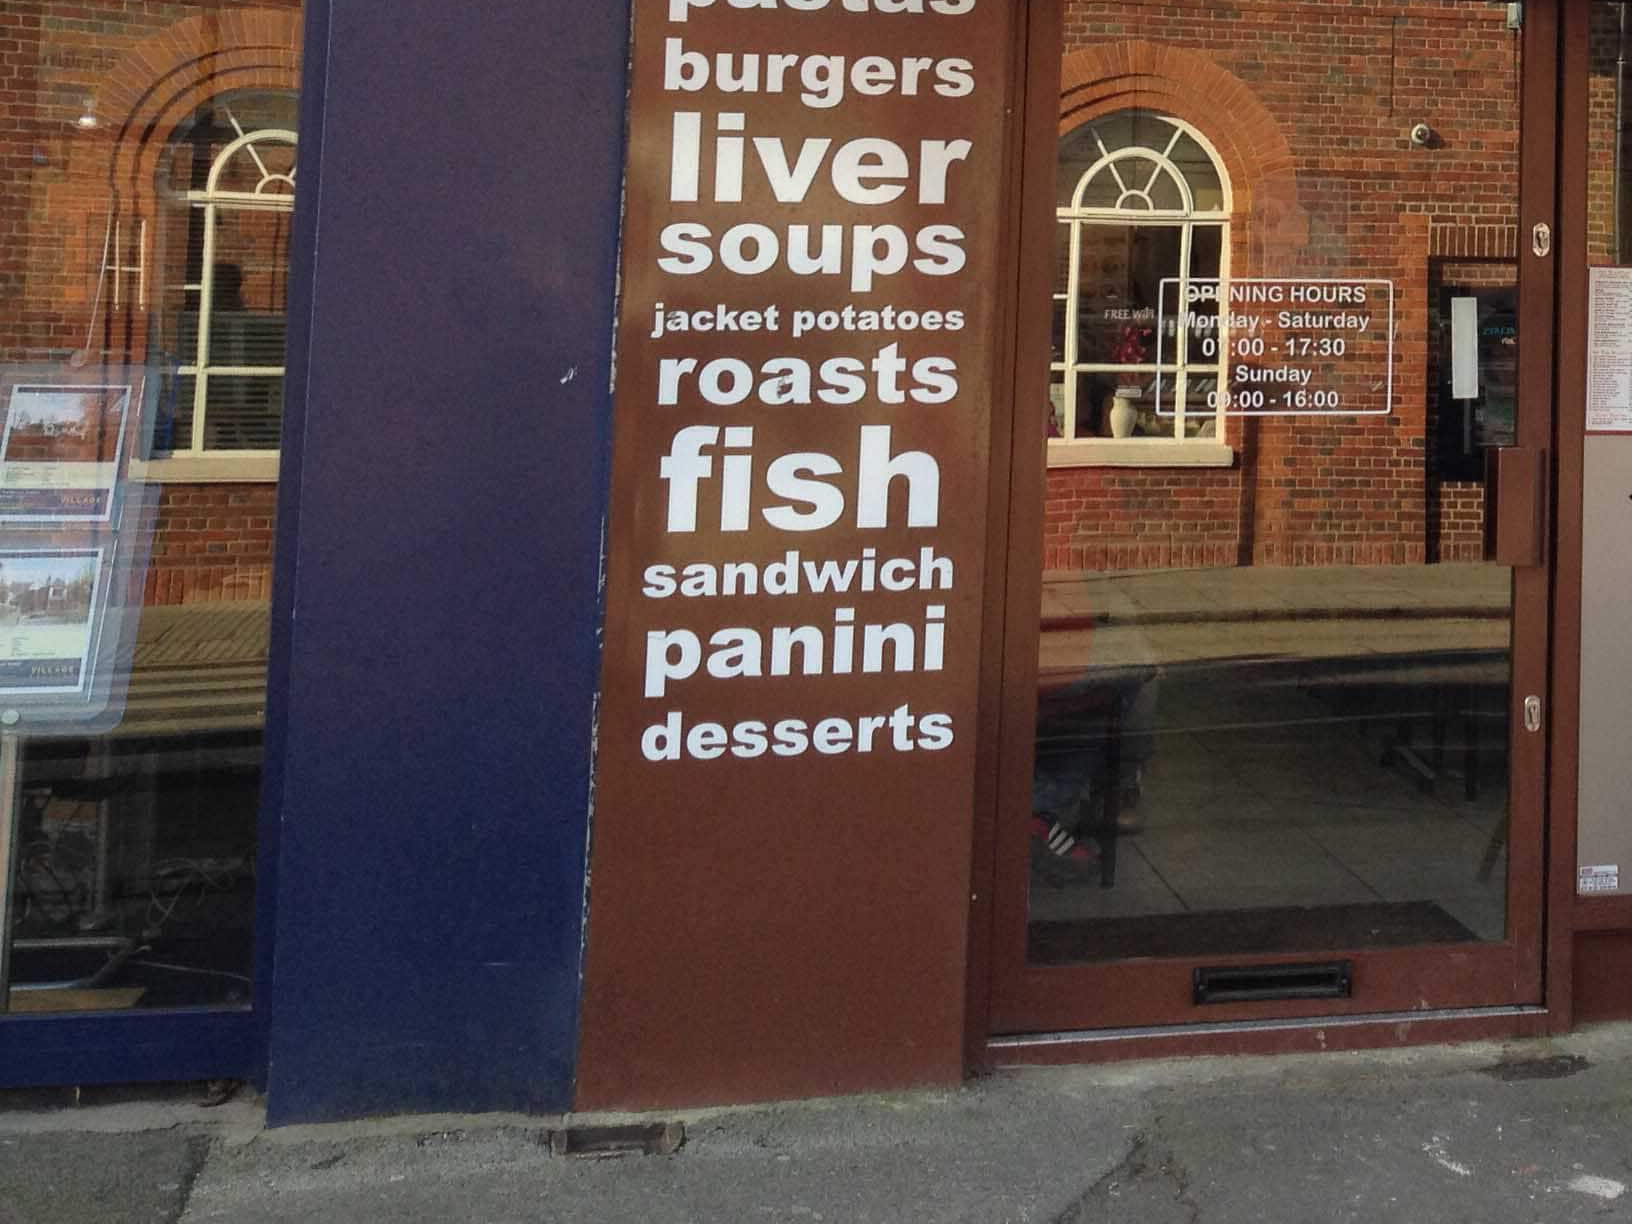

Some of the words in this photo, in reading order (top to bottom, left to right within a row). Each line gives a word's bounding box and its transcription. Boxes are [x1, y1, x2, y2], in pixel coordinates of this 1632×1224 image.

[664, 38, 974, 108] burgers
[671, 112, 972, 204] liver
[658, 223, 965, 292] soups
[651, 303, 779, 338] jacket
[793, 305, 964, 337] potatoes
[1278, 311, 1370, 333] Saturday
[1290, 286, 1367, 304] HOURS
[658, 342, 957, 405] roasts
[1202, 338, 1265, 357] 0:00
[1286, 338, 1346, 357] 17:30
[1207, 391, 1264, 408] 09:00
[1283, 391, 1339, 408] 16:00
[1235, 365, 1312, 385] Sunday
[660, 425, 939, 532] fish
[643, 547, 953, 598] sandwich
[645, 605, 945, 697] panini
[642, 704, 953, 761] desserts
